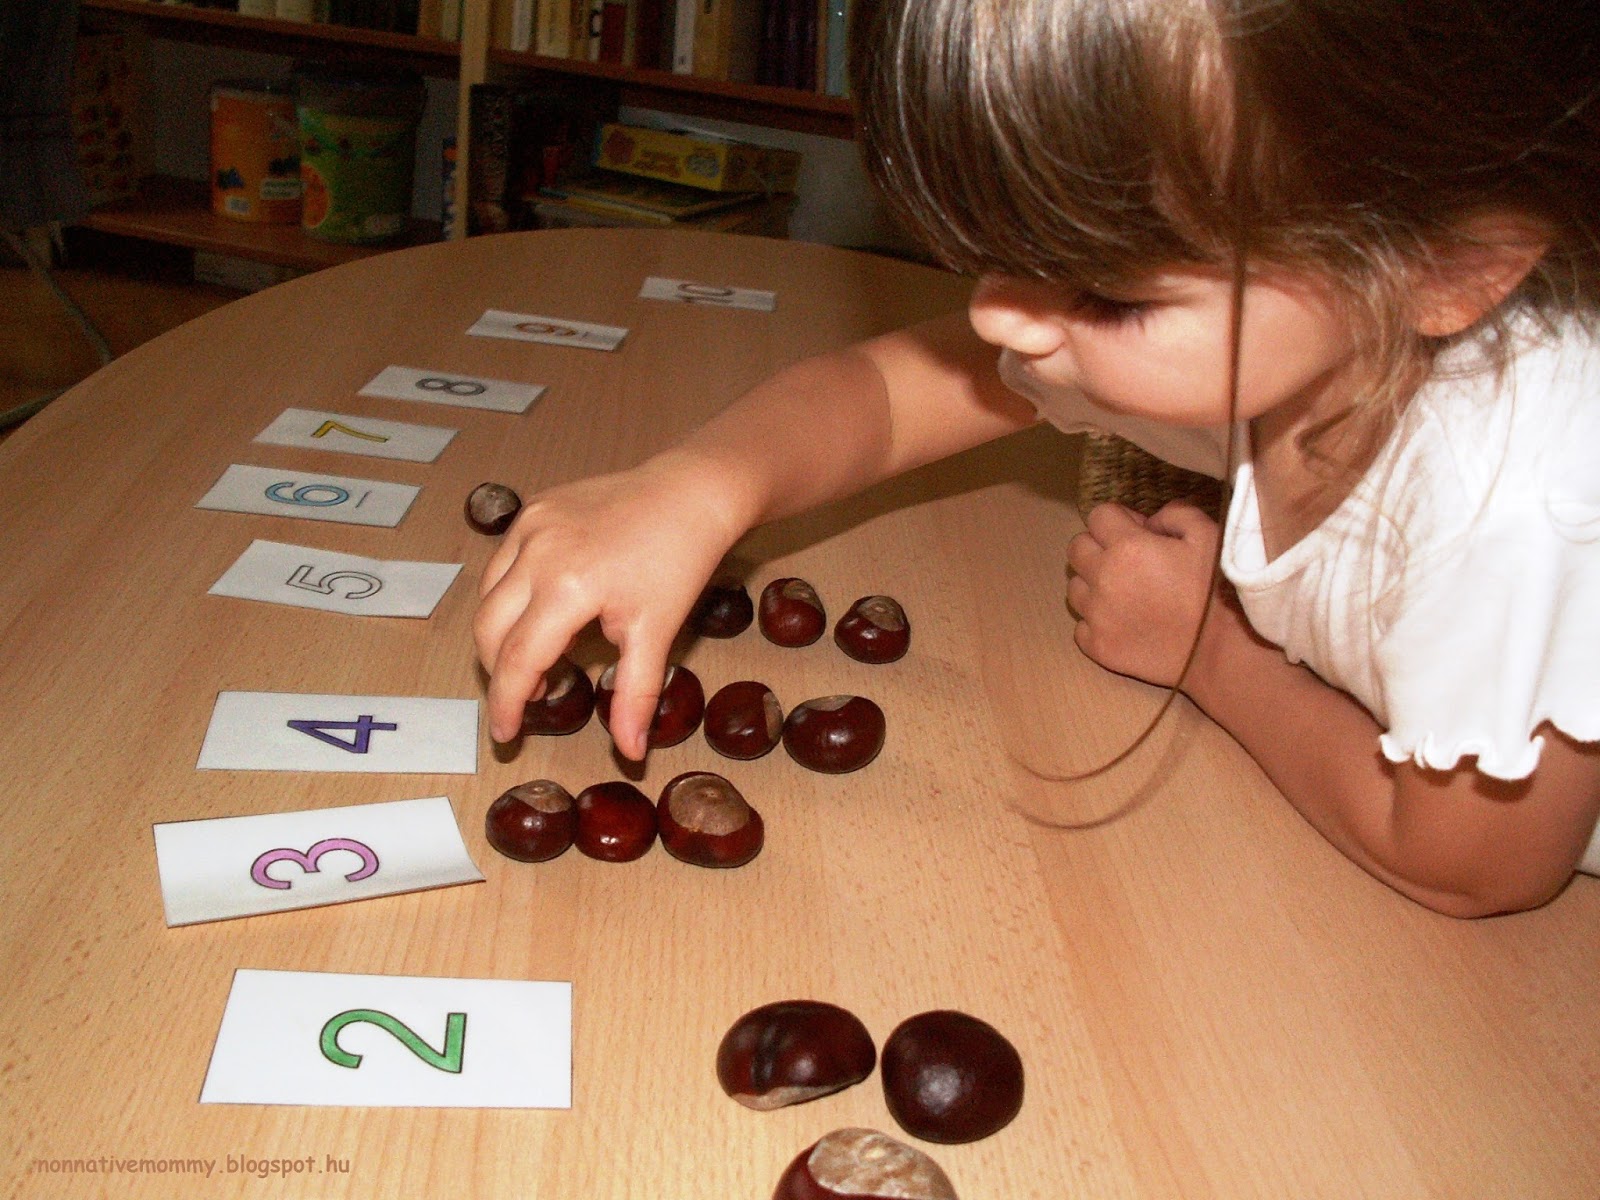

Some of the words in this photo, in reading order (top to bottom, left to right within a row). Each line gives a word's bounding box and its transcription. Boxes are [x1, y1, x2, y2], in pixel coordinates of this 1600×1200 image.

[676, 281, 734, 305] 10
[414, 376, 487, 397] 8
[311, 419, 390, 443] 7
[264, 481, 350, 507] 6
[285, 563, 383, 600] 5
[286, 714, 398, 754] 4
[250, 836, 380, 891] 3
[318, 1007, 468, 1074] 2
